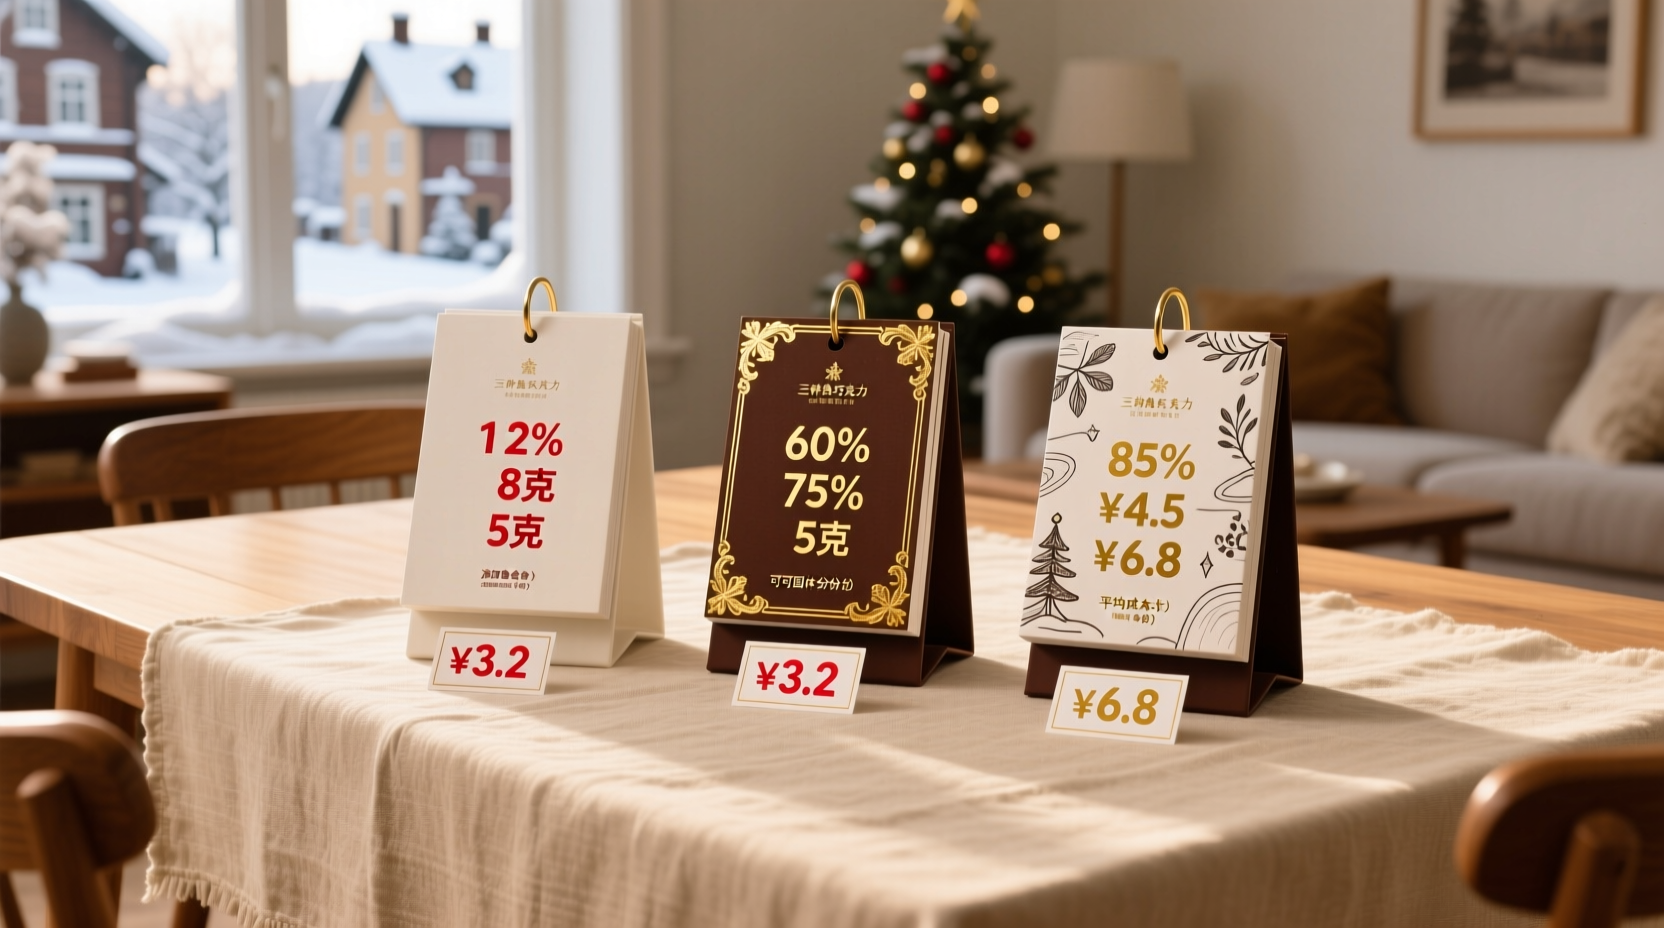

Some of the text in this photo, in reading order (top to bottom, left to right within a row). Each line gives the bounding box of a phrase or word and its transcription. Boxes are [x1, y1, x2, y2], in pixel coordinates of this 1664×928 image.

[480, 421, 563, 456] 12%
[785, 426, 869, 462] 60%
[1108, 441, 1195, 480] 85%
[498, 468, 556, 502] 8克
[784, 473, 863, 510] 75%
[1100, 492, 1185, 528] ¥4.5
[487, 513, 545, 549] 5克
[793, 521, 851, 556] 5克
[1094, 540, 1181, 578] ¥6.8
[450, 644, 529, 679] ¥3.2
[756, 659, 838, 697] ¥3.2
[1072, 687, 1159, 725] ¥6.8
